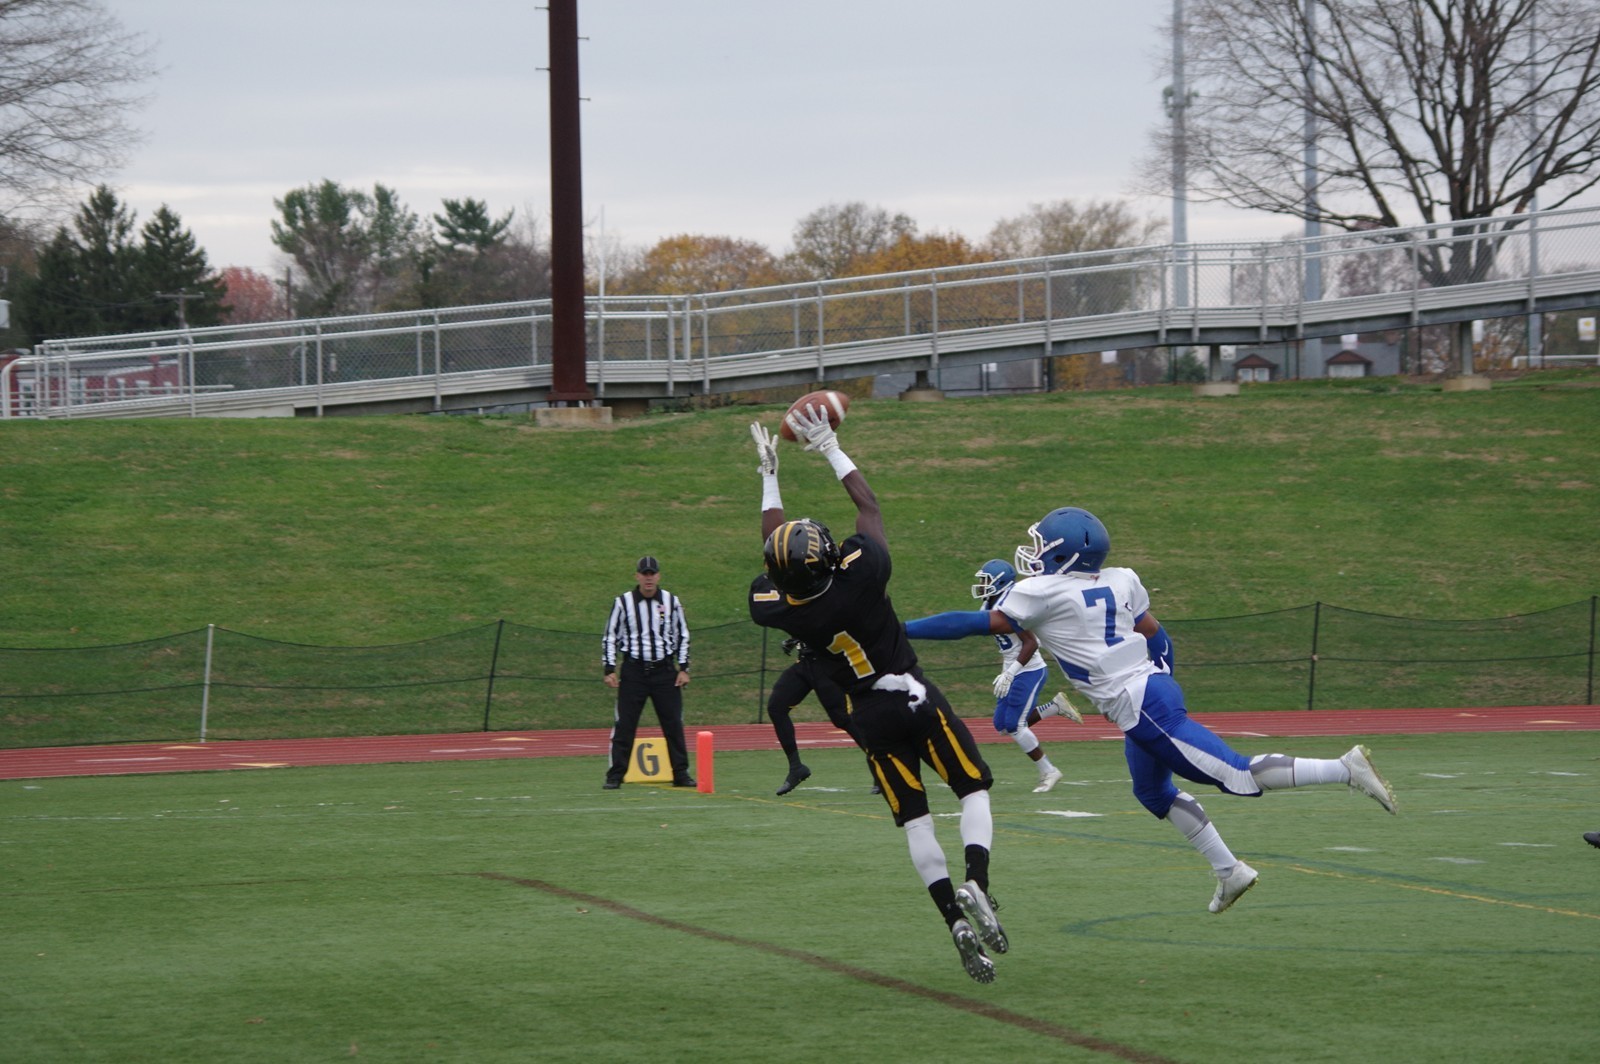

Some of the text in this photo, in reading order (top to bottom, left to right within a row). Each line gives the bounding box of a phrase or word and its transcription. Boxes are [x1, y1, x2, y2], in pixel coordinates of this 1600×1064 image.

[840, 549, 862, 570] 1
[753, 589, 780, 602] 1
[1081, 586, 1125, 648] 7
[826, 630, 876, 679] 1
[637, 743, 660, 776] G
